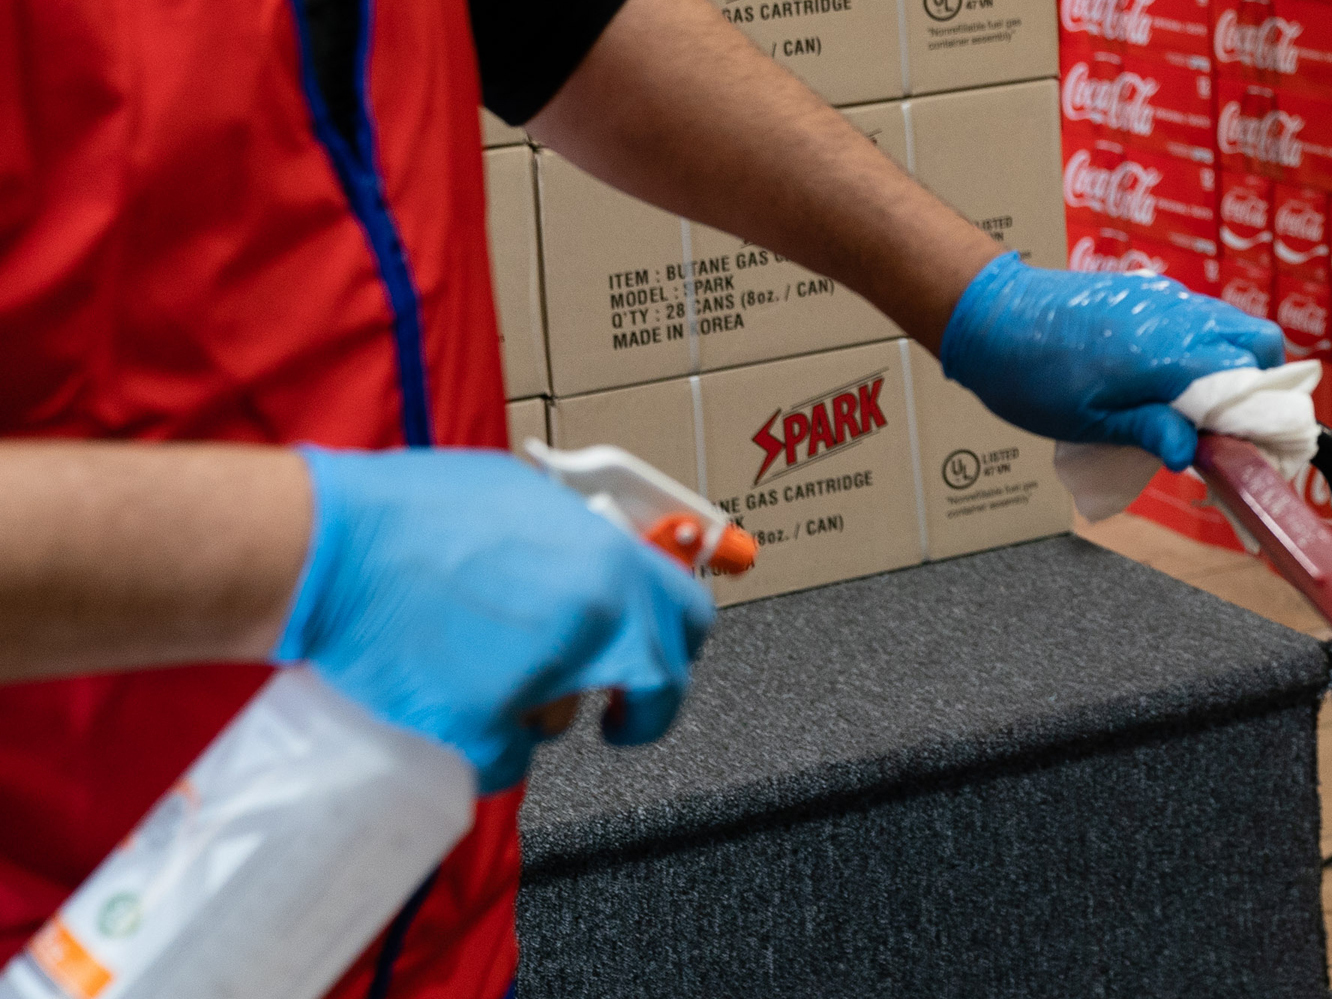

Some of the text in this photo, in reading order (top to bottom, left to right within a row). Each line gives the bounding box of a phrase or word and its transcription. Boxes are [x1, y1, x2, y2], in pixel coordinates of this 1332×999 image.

[782, 36, 823, 58] CAN)
[608, 269, 650, 291] ITEM
[736, 250, 770, 270] GAS
[609, 285, 669, 311] MODEL
[611, 308, 650, 330] Q'TY
[665, 302, 686, 321] 28
[740, 288, 780, 311] (8oz.
[797, 277, 835, 298] CAN)
[612, 327, 662, 351] MADE
[666, 323, 684, 341] IN
[751, 376, 888, 486] SPARK
[744, 489, 779, 512] GAS
[783, 469, 875, 502] CARTRIDGE
[806, 514, 845, 536] CAN)
